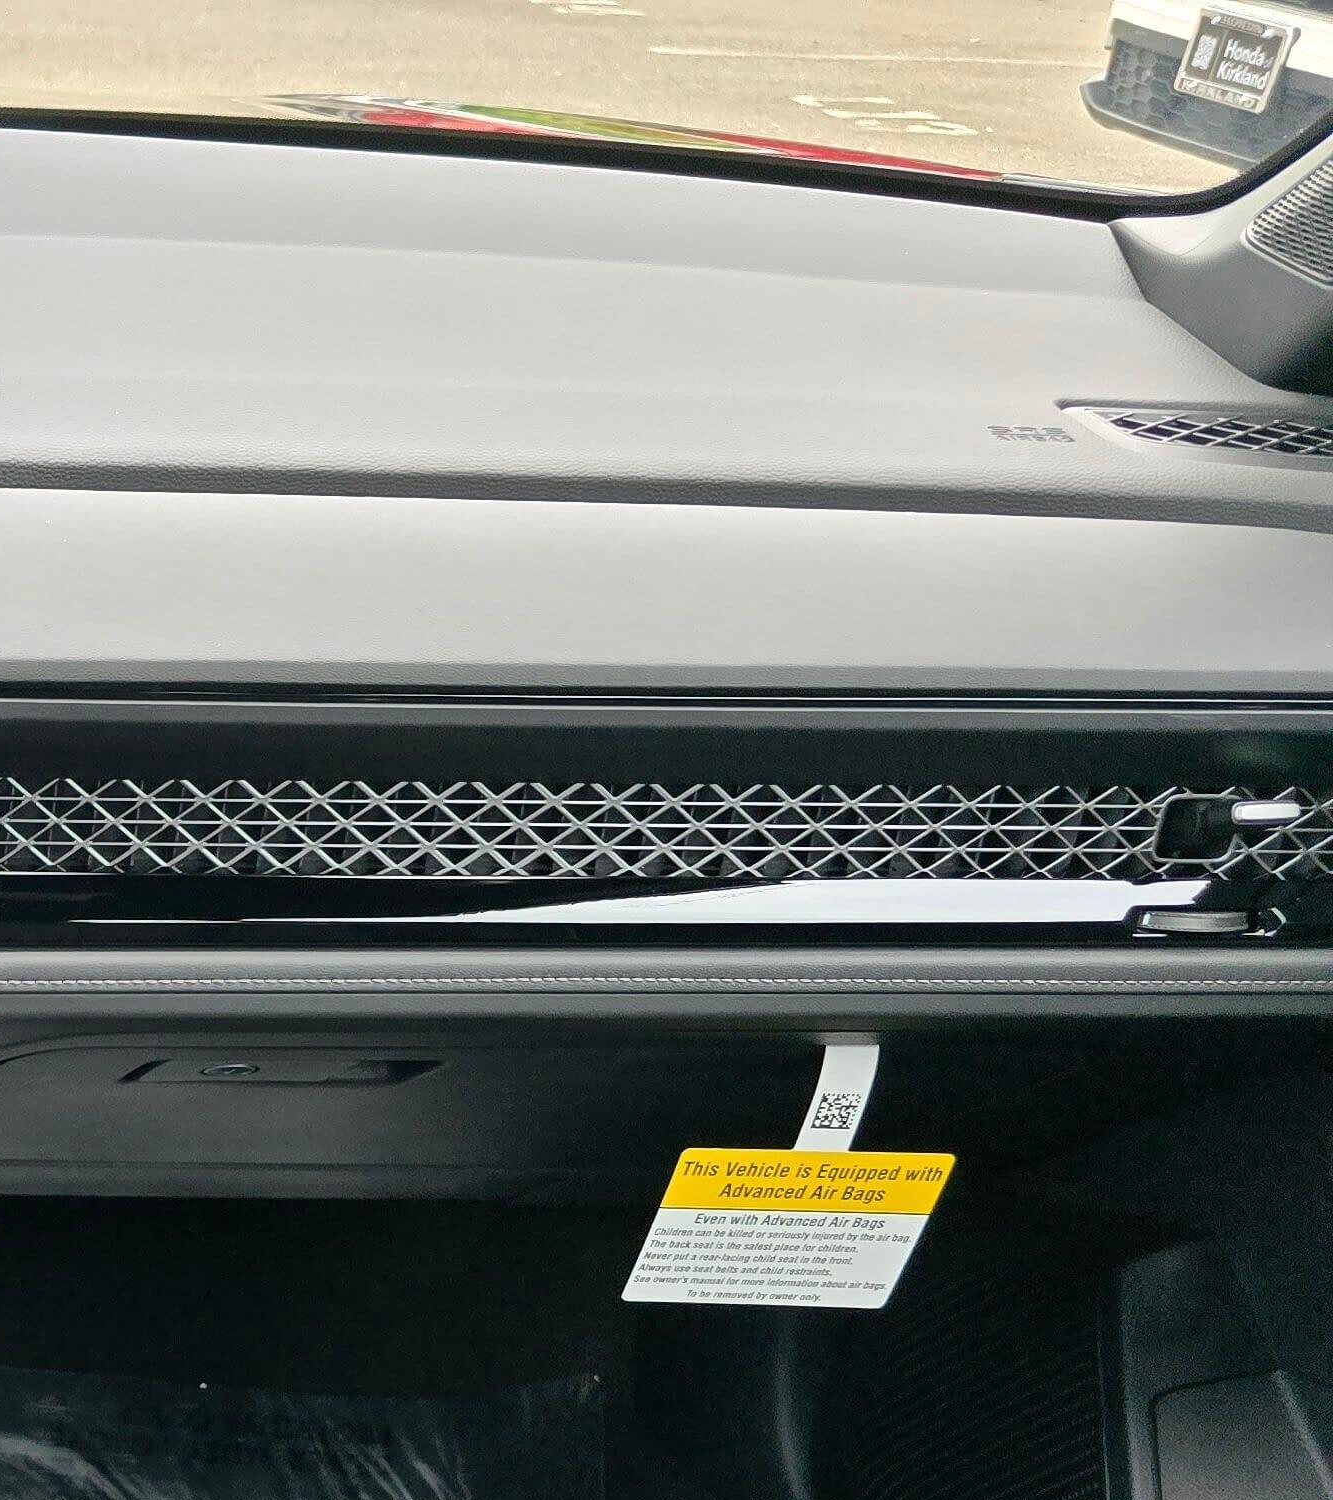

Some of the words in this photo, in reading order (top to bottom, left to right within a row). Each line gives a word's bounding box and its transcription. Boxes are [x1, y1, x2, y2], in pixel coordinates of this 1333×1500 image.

[1223, 38, 1265, 66] Honda
[1216, 60, 1269, 90] Kirkland
[683, 1161, 720, 1177] This
[726, 1161, 791, 1178] Vehicle
[796, 1163, 812, 1178] is
[816, 1163, 901, 1183] Equipped
[905, 1166, 943, 1182] with
[718, 1183, 807, 1200] Advanced
[809, 1184, 838, 1200] Air
[841, 1185, 886, 1204] Bags
[694, 1213, 727, 1225] Even
[730, 1214, 759, 1225] with
[760, 1214, 828, 1227] Advanced
[828, 1216, 851, 1228] Air
[852, 1217, 886, 1231] Bags
[654, 1227, 694, 1238] Children
[714, 1229, 726, 1238] be
[728, 1229, 754, 1239] killed
[755, 1231, 766, 1239] or
[767, 1230, 809, 1241] seriously
[811, 1231, 844, 1242] injured
[846, 1232, 858, 1242] by
[860, 1233, 875, 1242] the
[876, 1233, 890, 1242] air
[649, 1239, 667, 1249] The
[668, 1239, 691, 1249] back
[693, 1240, 714, 1249] seat
[715, 1240, 724, 1250] is
[725, 1240, 741, 1250] the
[643, 1251, 672, 1261] Never
[673, 1252, 690, 1262] put
[752, 1253, 776, 1263] child
[777, 1254, 798, 1264] seat
[638, 1263, 672, 1274] Always
[694, 1264, 714, 1274] seat
[740, 1265, 758, 1274] and
[759, 1265, 783, 1275] child
[633, 1274, 651, 1283] See
[686, 1289, 697, 1298] To
[698, 1290, 711, 1298] be
[712, 1290, 753, 1299] removed
[755, 1290, 768, 1300] by
